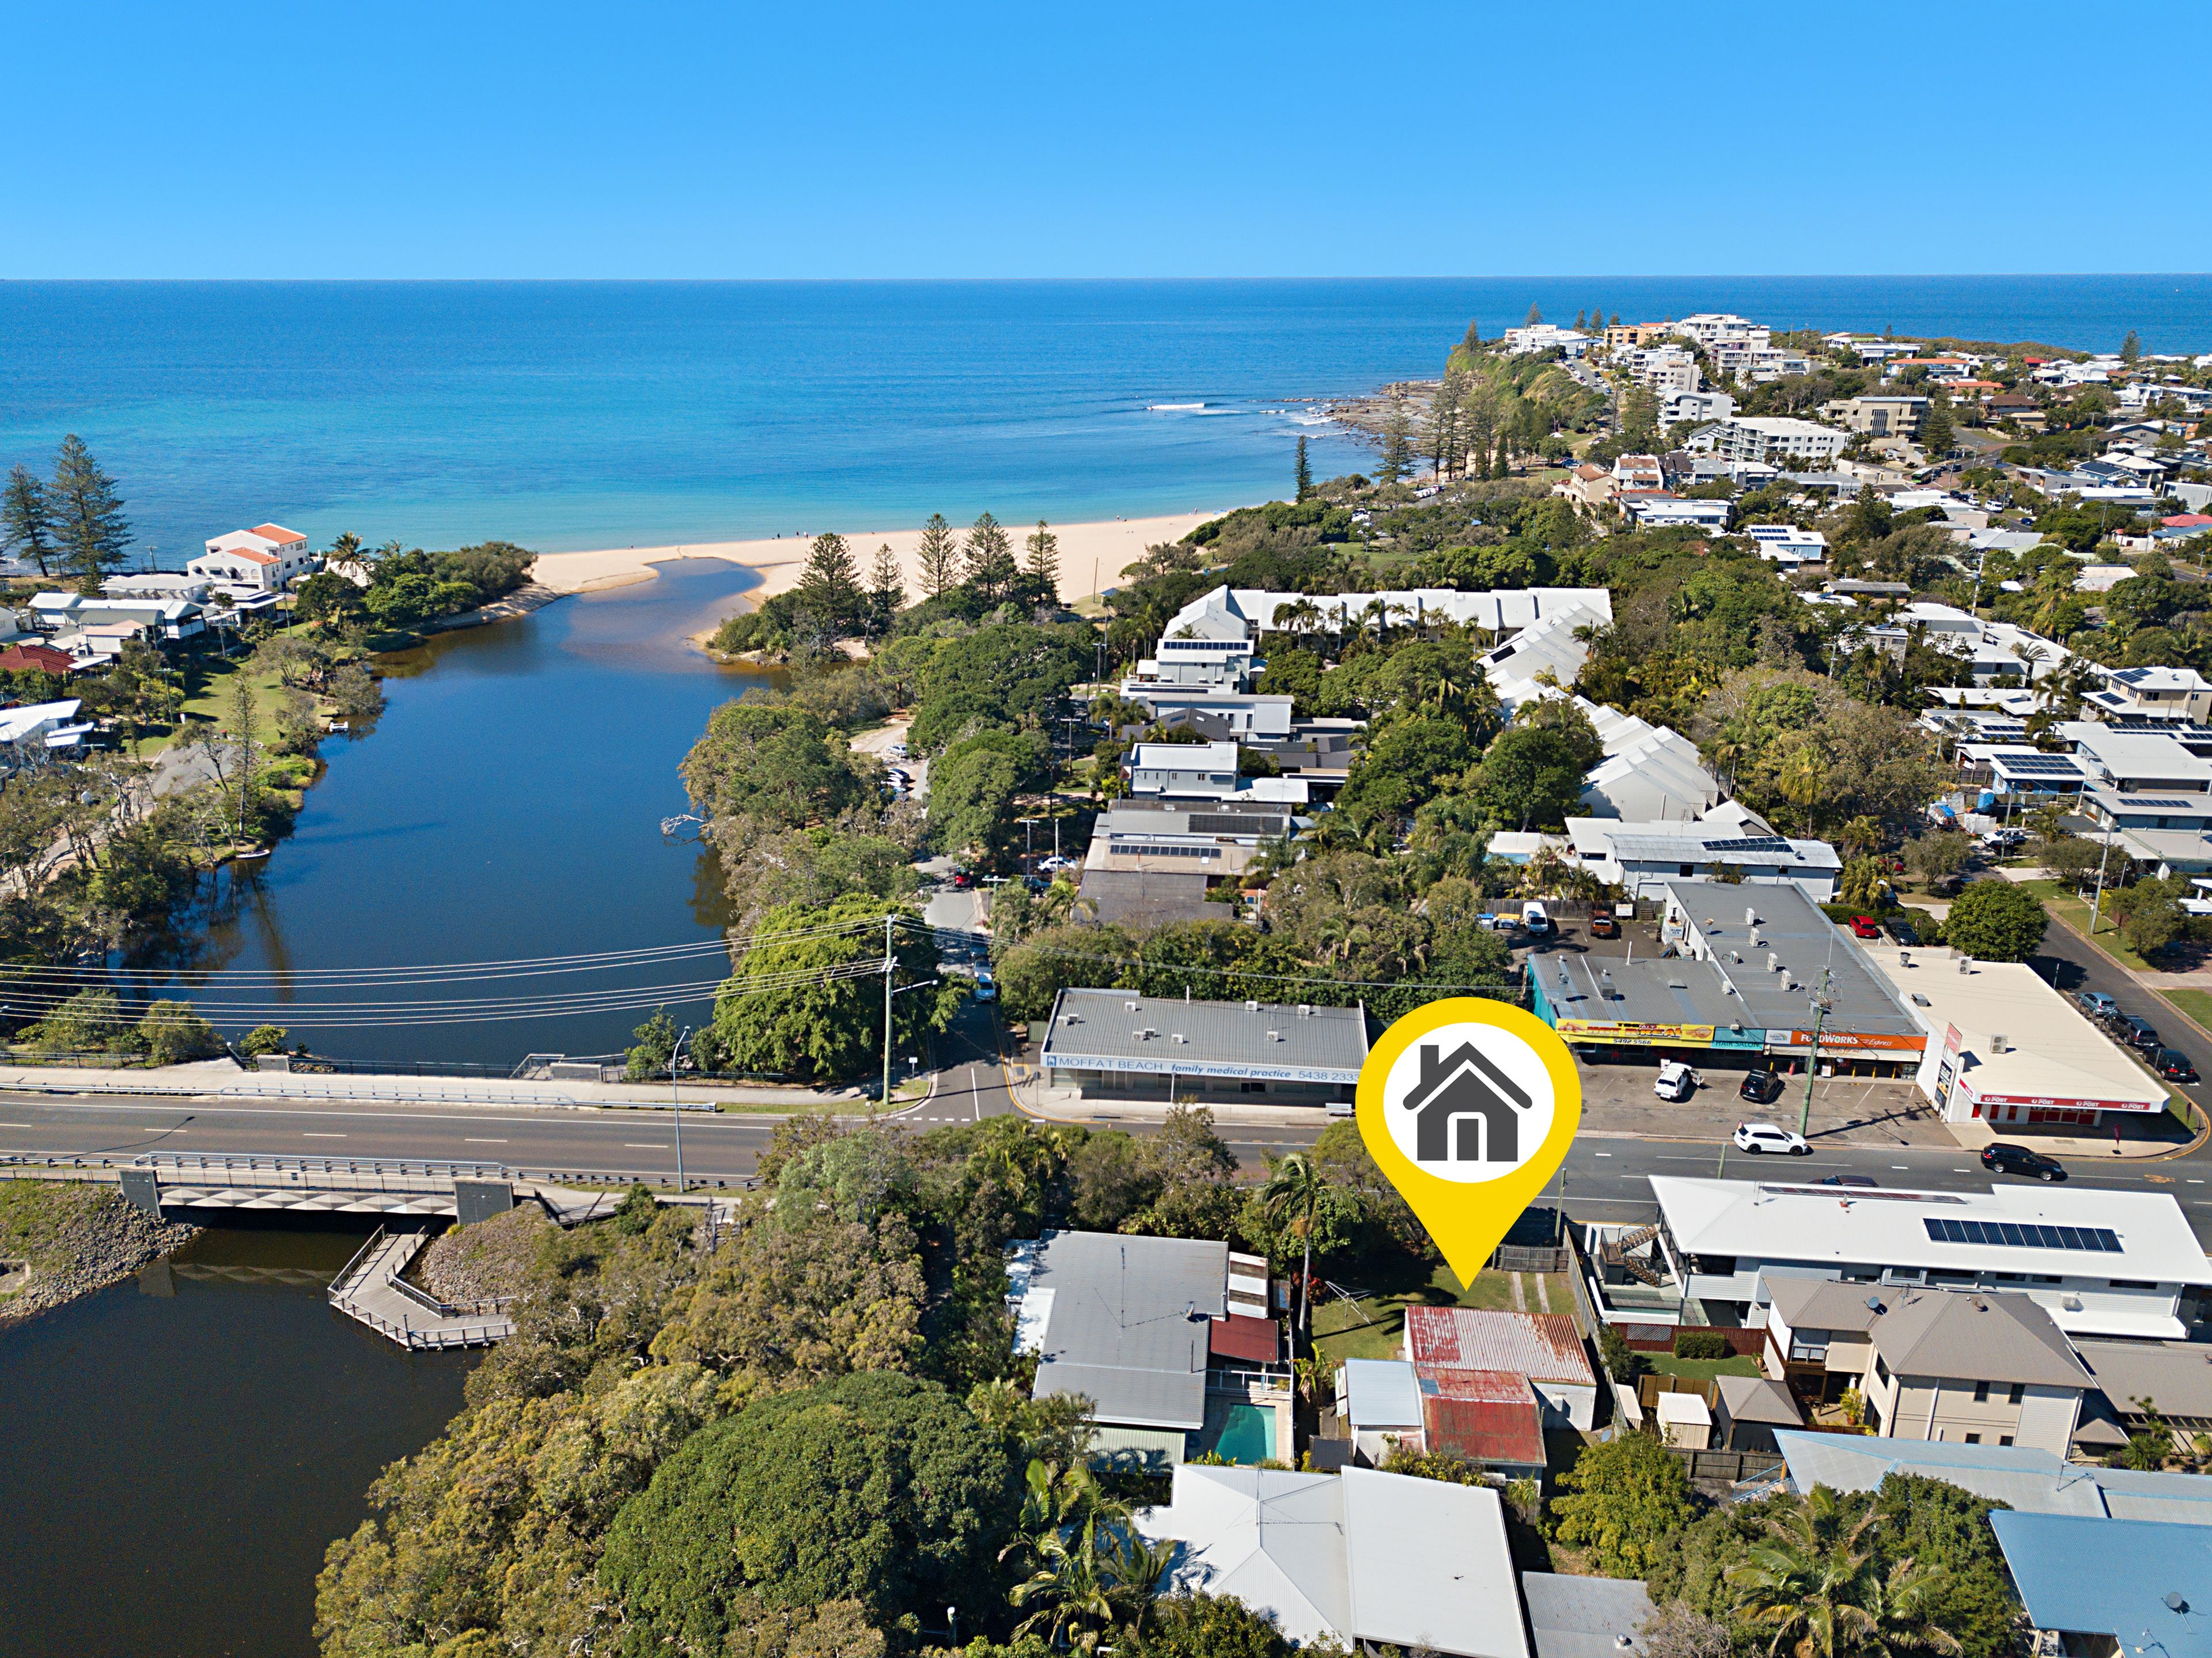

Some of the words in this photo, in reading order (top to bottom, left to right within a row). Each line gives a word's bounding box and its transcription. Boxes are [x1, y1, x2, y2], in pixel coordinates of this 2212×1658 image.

[1800, 1034, 1858, 1044] FODWORKS
[1868, 1039, 1892, 1047] Express
[1059, 1058, 1114, 1068] MOFFAT
[1118, 1061, 1162, 1070] BEACH
[1172, 1064, 1203, 1075] family
[1207, 1067, 1247, 1076] medical
[1250, 1069, 1290, 1078] practice
[1298, 1071, 1328, 1080] 5438
[1331, 1073, 1359, 1082] 2333
